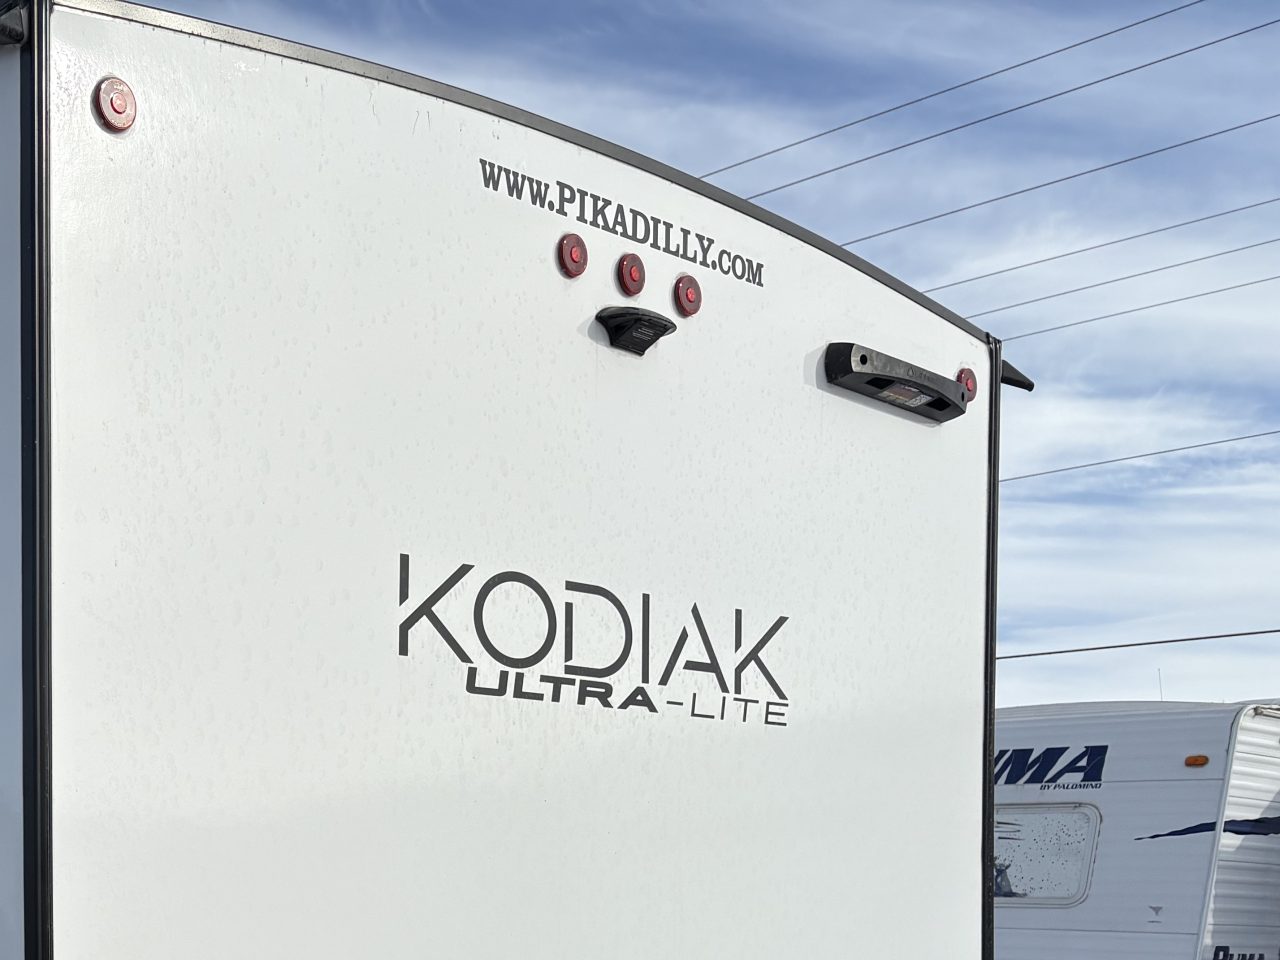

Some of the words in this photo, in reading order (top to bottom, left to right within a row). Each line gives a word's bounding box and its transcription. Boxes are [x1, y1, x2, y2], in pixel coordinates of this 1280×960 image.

[479, 158, 764, 287] WWW.PIKADILLY.COM
[398, 553, 789, 700] KODIAK
[465, 667, 788, 726] ULTRA-LITE
[1053, 782, 1102, 790] PALOMINO
